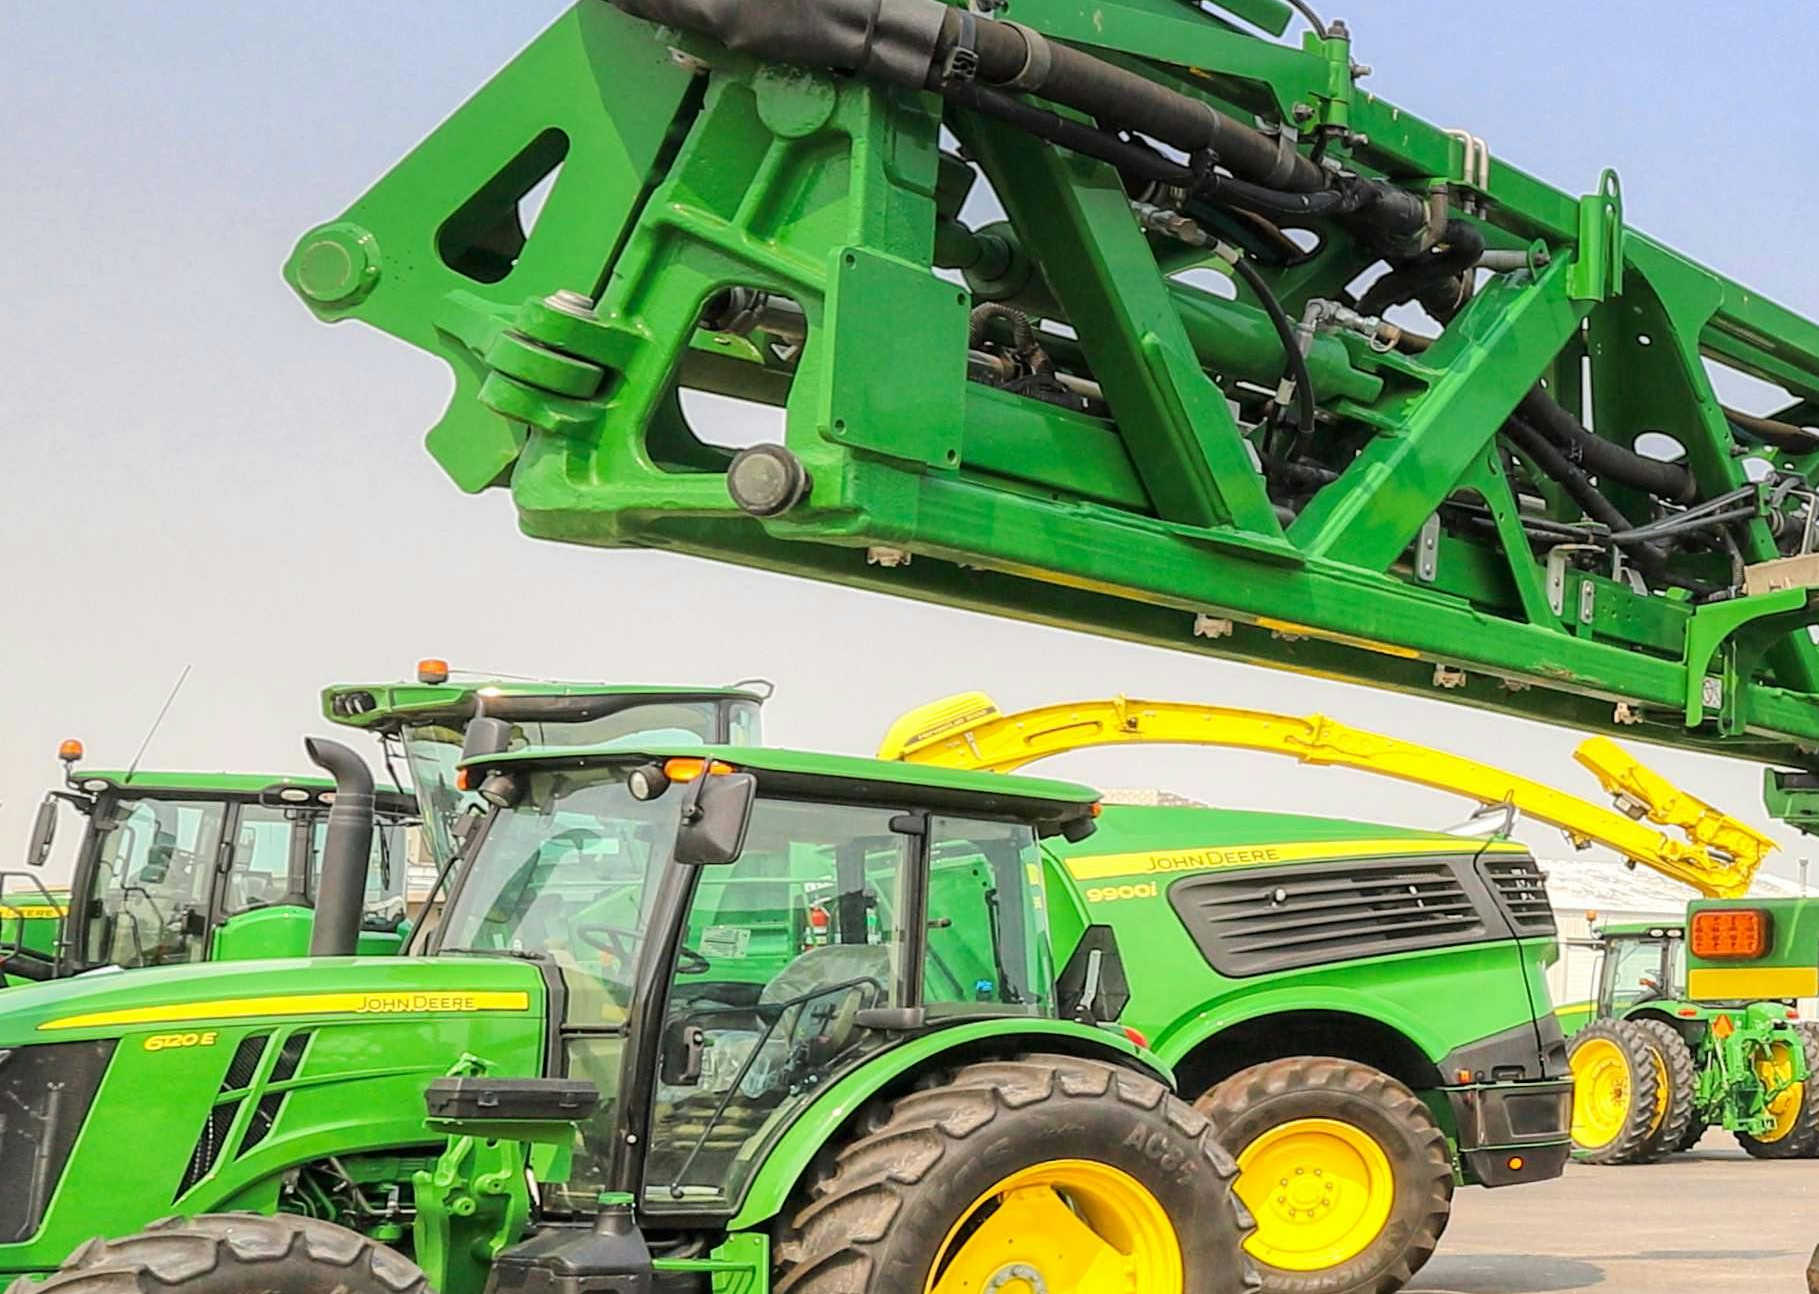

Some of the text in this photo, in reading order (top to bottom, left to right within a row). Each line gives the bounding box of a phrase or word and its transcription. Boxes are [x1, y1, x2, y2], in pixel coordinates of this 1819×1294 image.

[1146, 848, 1280, 872] JOHN DEERE
[1086, 881, 1158, 902] 9900i
[357, 995, 476, 1010] JOHN DEERE
